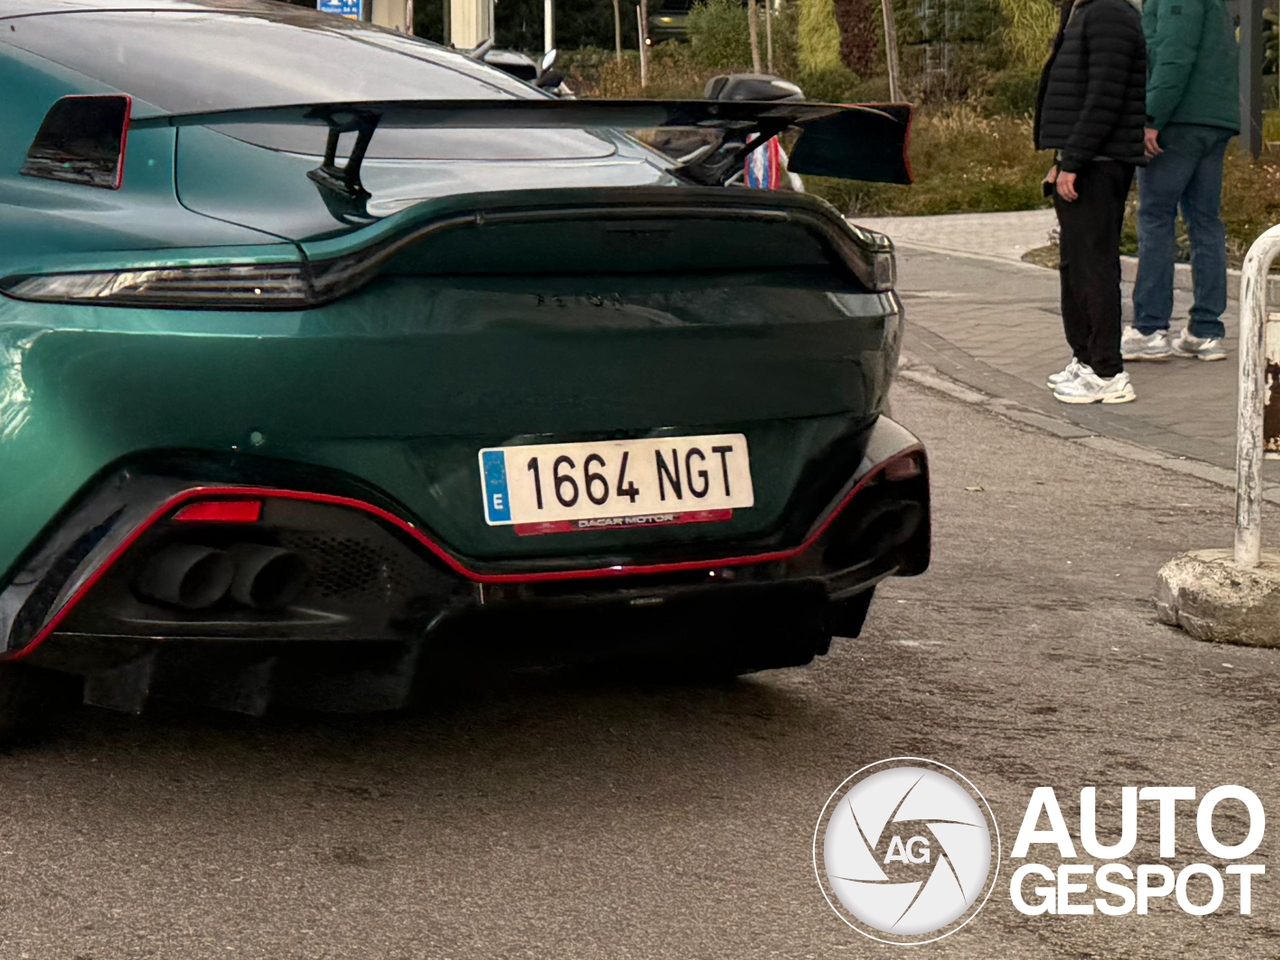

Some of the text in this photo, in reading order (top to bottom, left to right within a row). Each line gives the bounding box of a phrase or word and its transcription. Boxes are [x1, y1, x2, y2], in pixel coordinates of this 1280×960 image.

[527, 445, 733, 510] 1664 NGT
[493, 494, 504, 510] E
[625, 514, 673, 524] MOTOR
